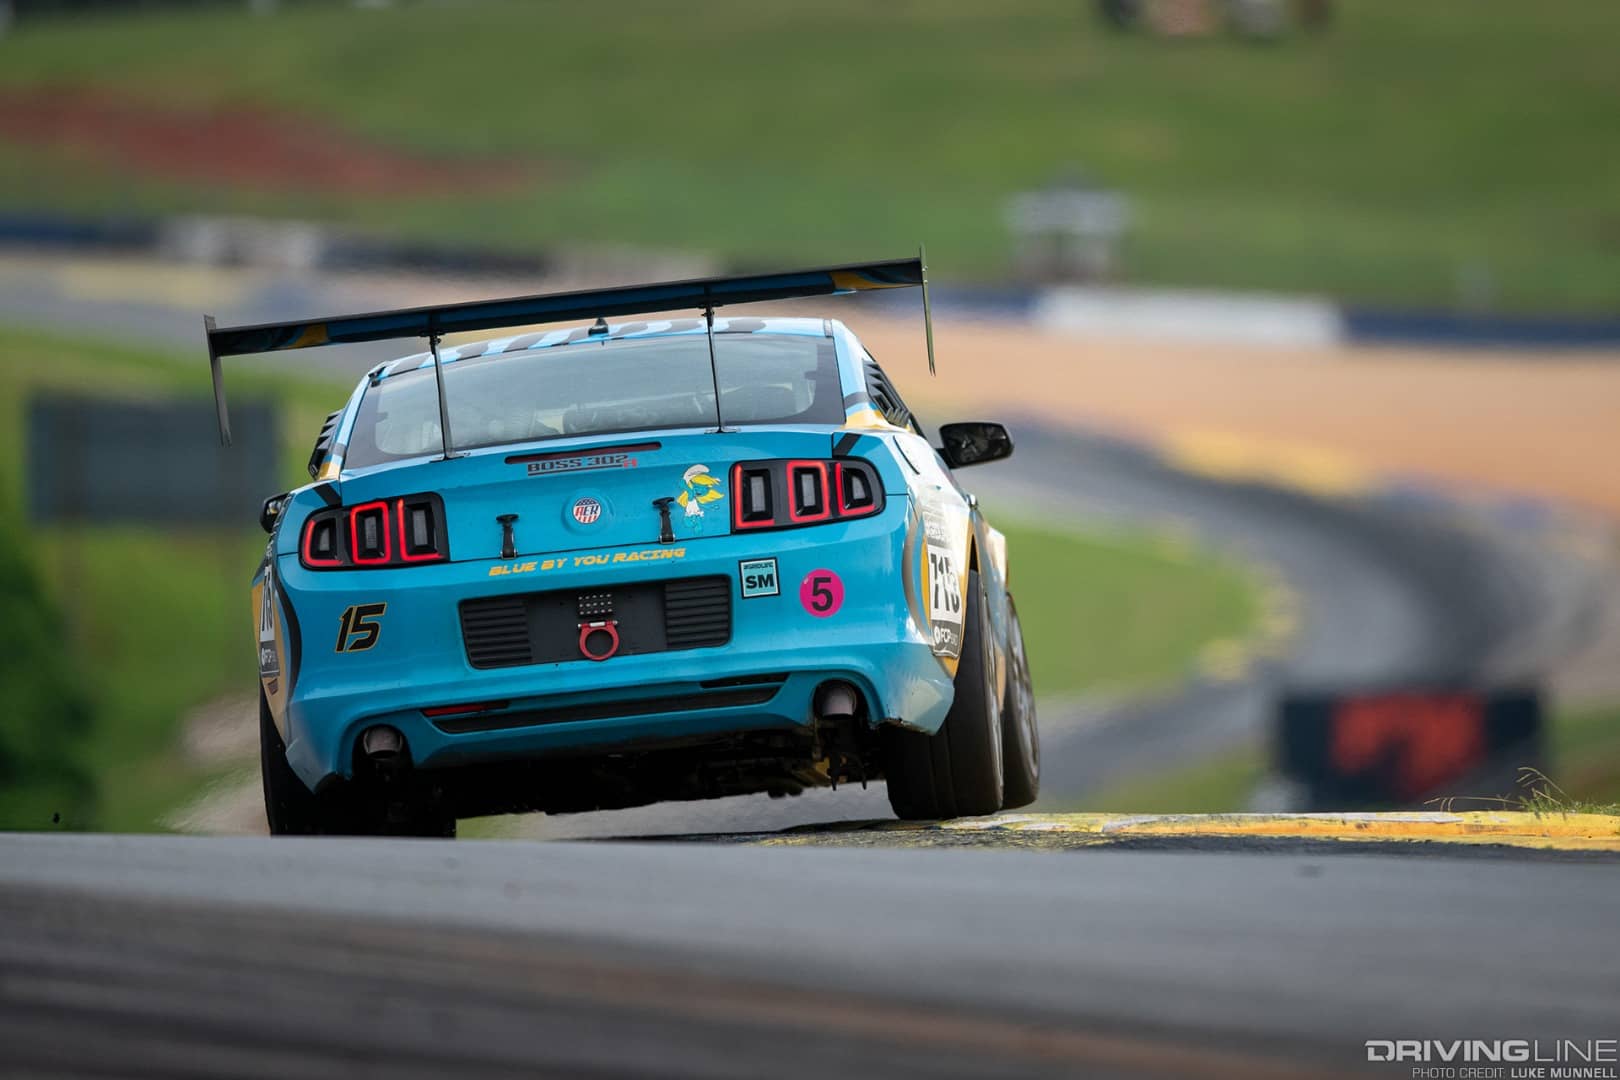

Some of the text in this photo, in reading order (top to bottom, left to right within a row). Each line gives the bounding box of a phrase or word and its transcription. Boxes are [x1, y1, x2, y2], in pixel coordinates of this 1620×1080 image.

[527, 458, 582, 473] BOSS
[488, 548, 686, 577] BLUE BY YOU RACING
[745, 573, 775, 589] SM
[811, 576, 833, 612] 5
[335, 601, 387, 654] 15
